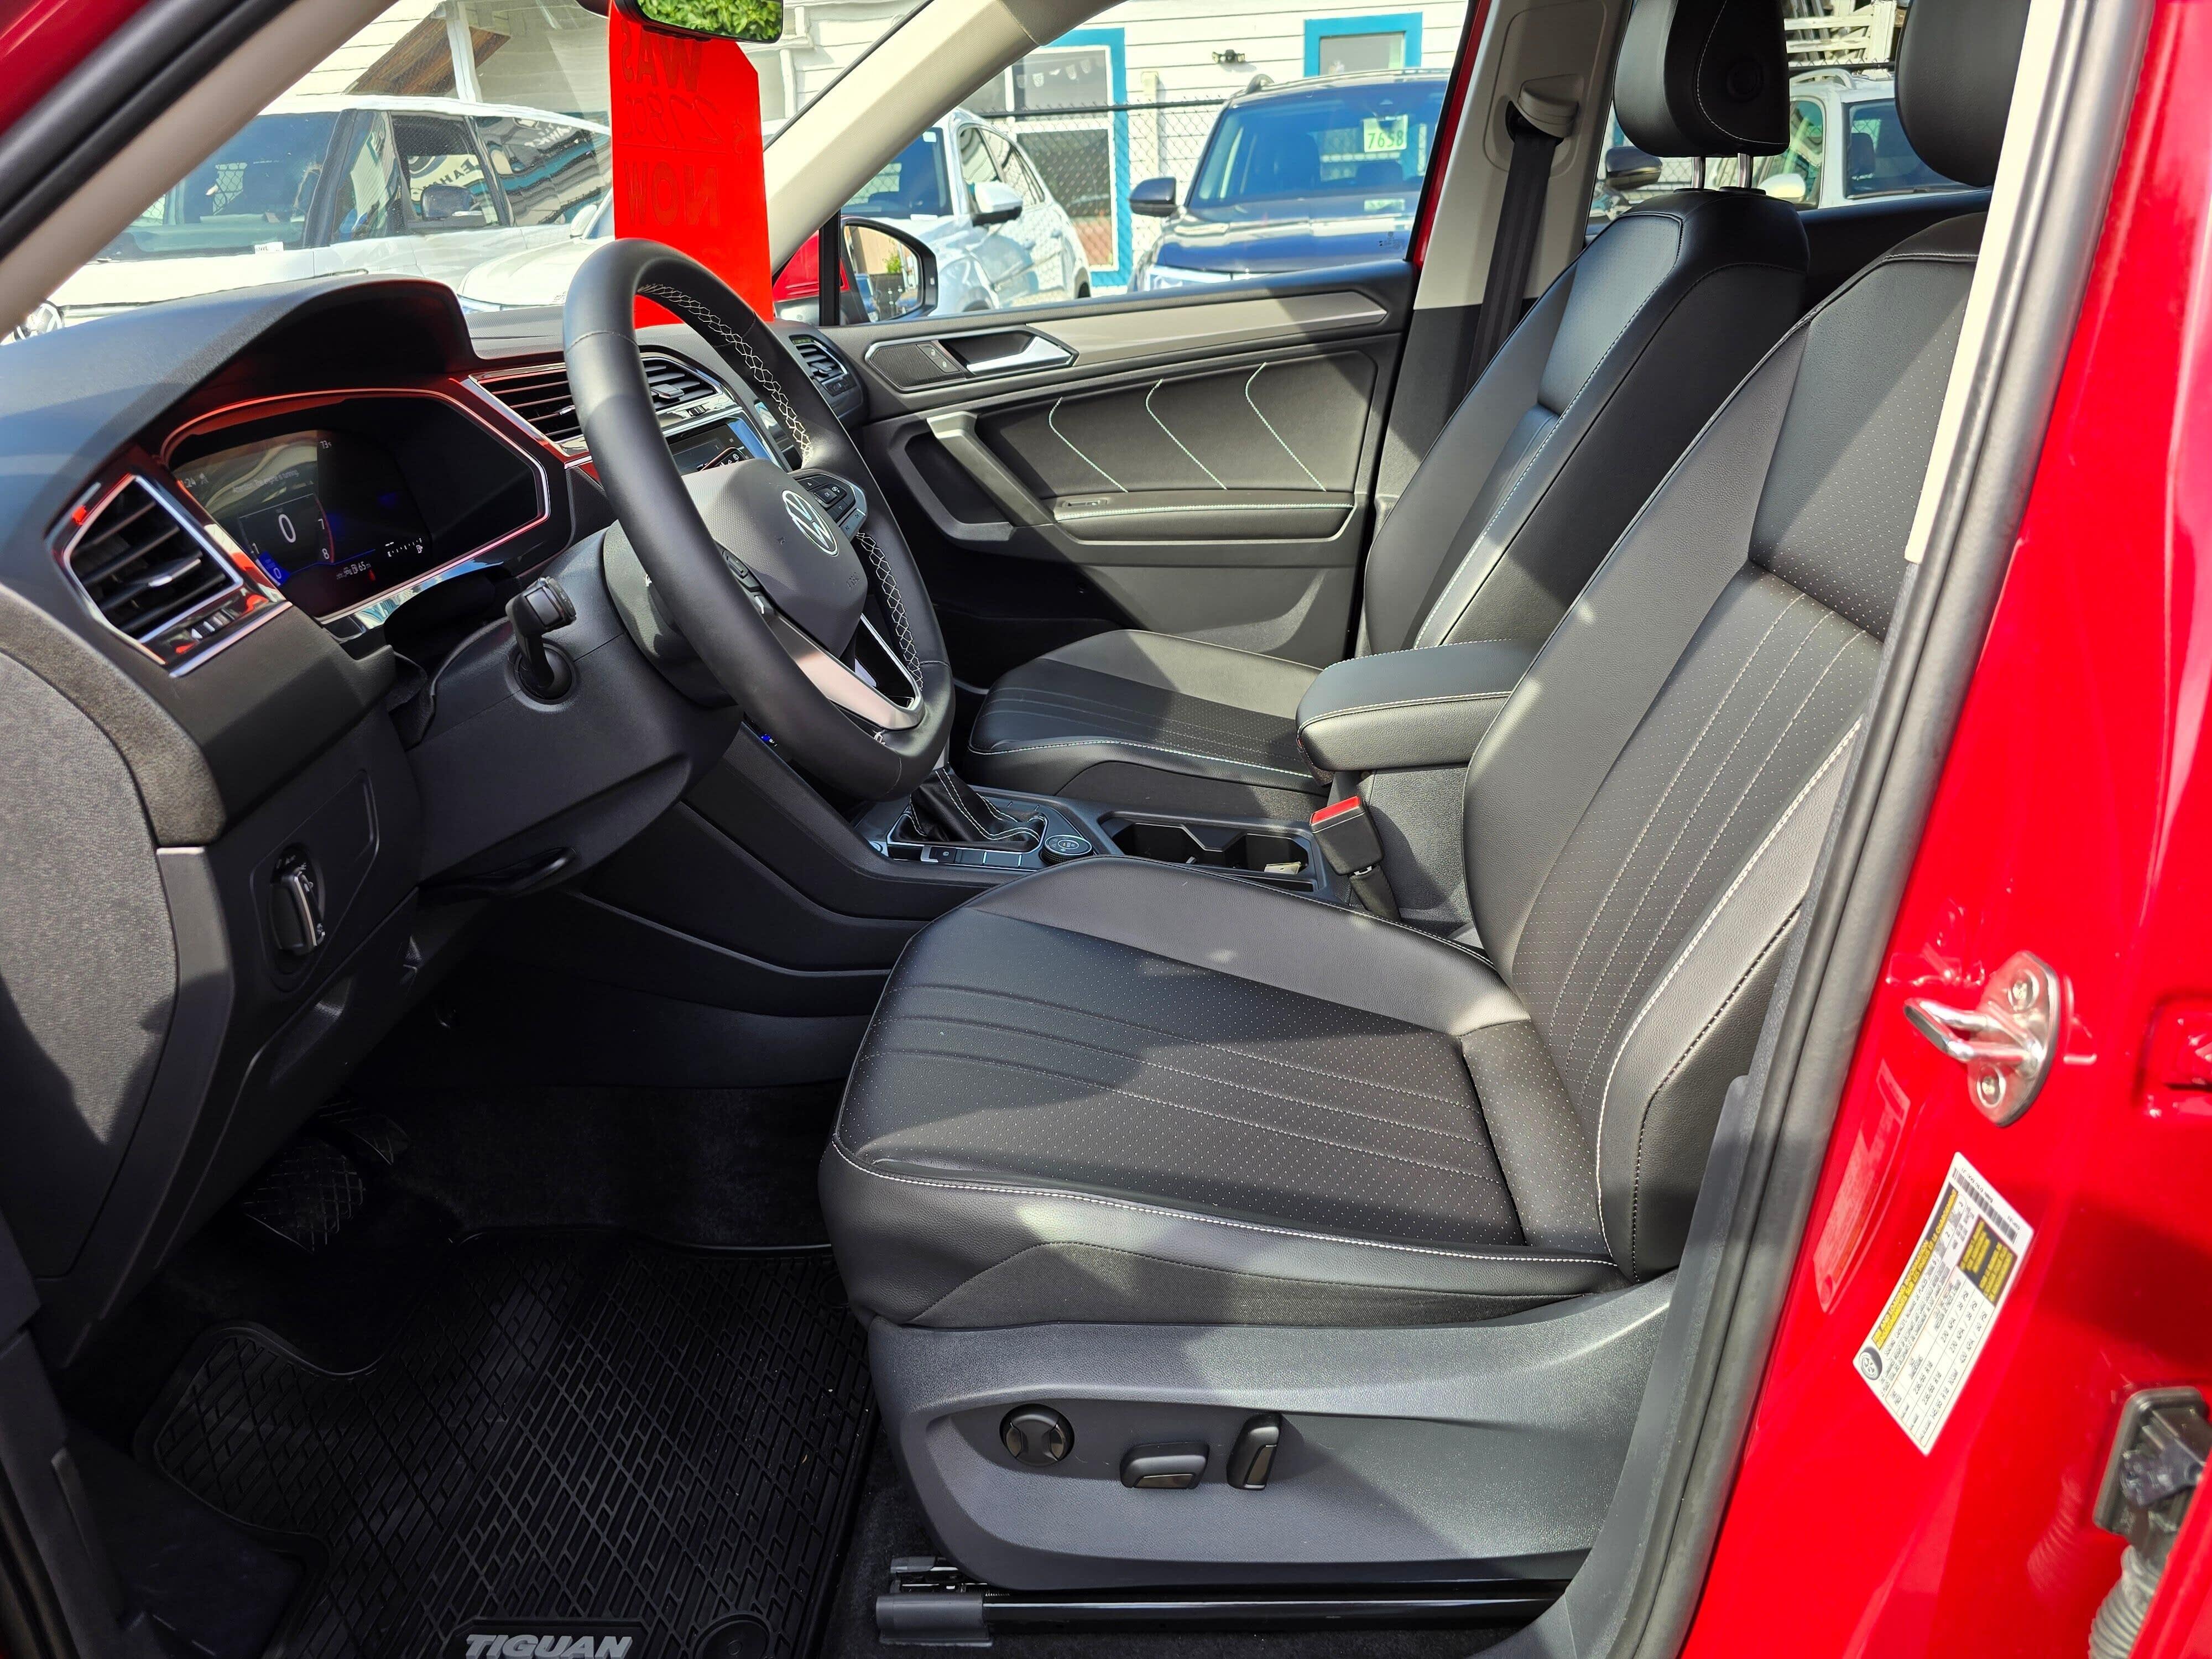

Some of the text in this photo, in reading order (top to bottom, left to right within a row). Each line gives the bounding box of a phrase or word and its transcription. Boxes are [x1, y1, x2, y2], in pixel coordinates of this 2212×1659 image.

[1368, 130, 1404, 149] 7658
[278, 514, 296, 543] 0
[317, 518, 325, 530] 7
[322, 547, 330, 560] 8
[358, 561, 366, 571] 65
[466, 1634, 633, 1659] TIGUAN
